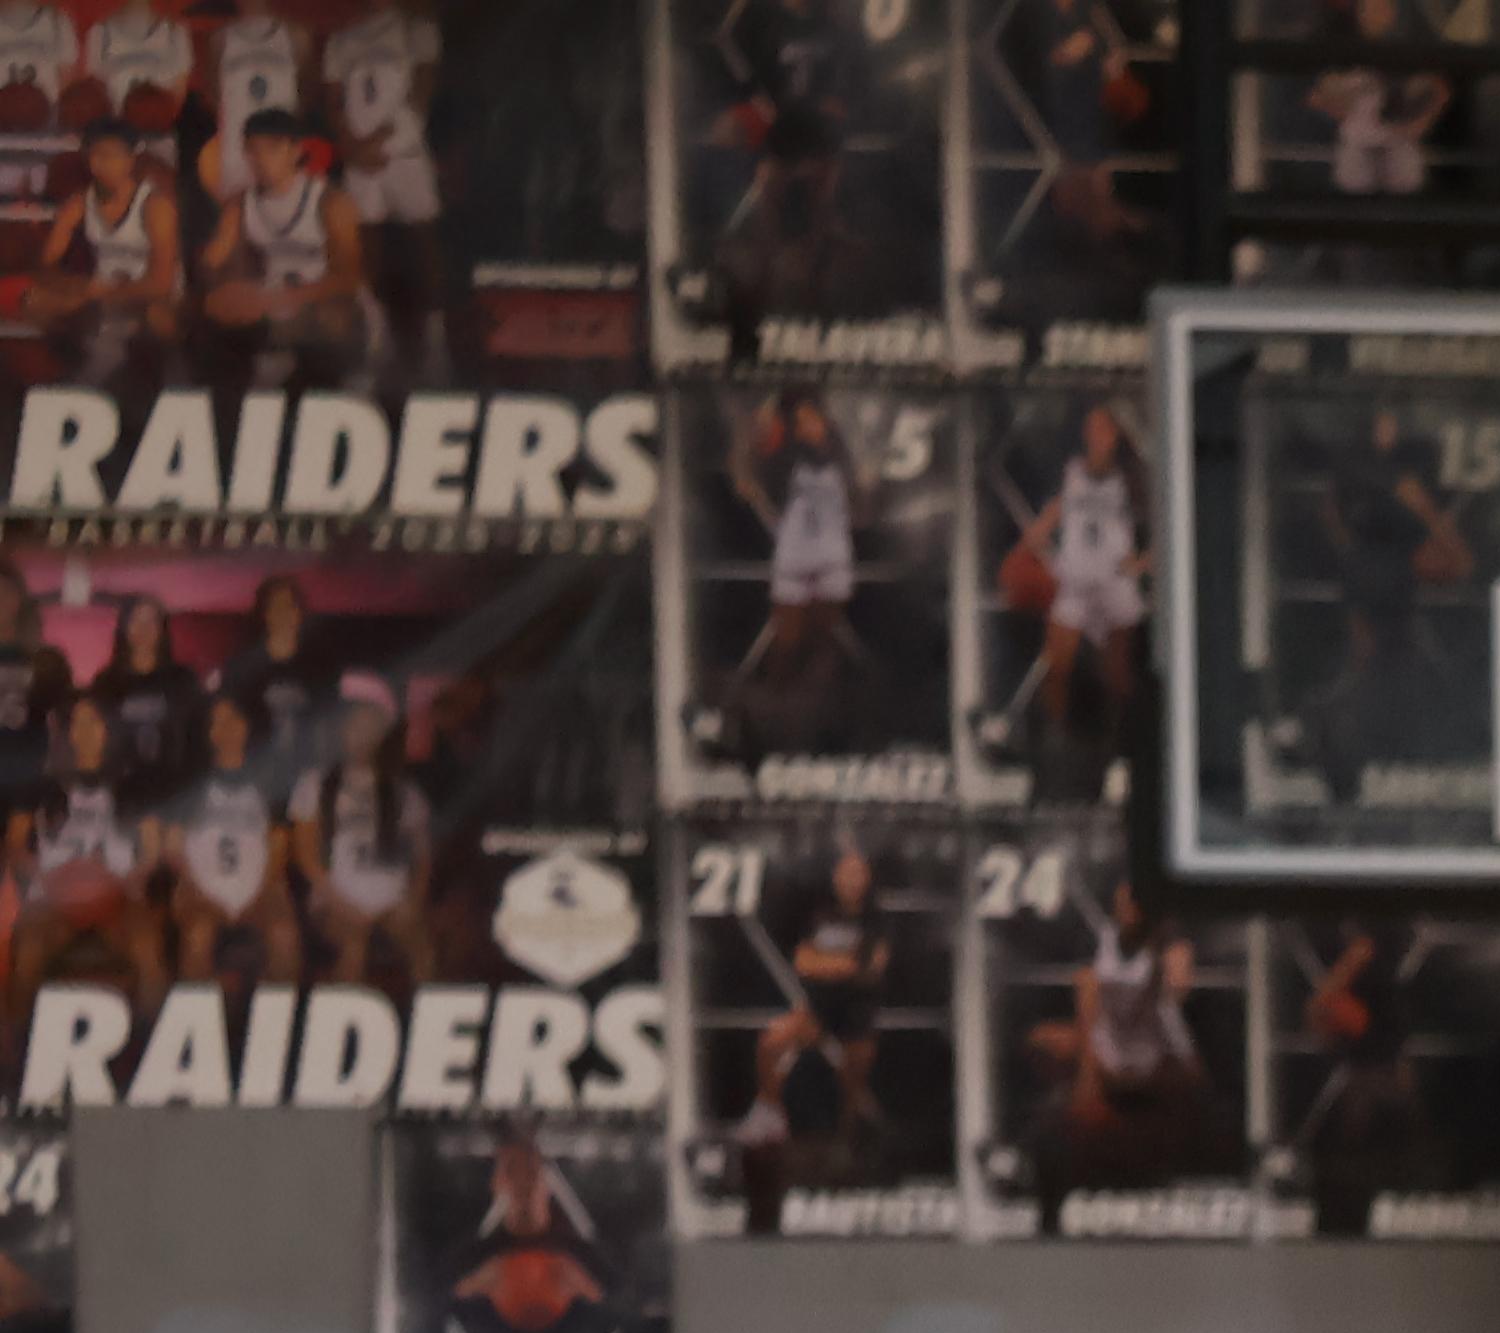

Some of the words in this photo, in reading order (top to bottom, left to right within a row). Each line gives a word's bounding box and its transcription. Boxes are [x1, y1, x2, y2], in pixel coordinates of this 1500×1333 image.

[8, 383, 662, 520] RAIDERS
[689, 842, 768, 920] 21
[973, 842, 1068, 922] 24
[16, 982, 670, 1110] RAIDERS
